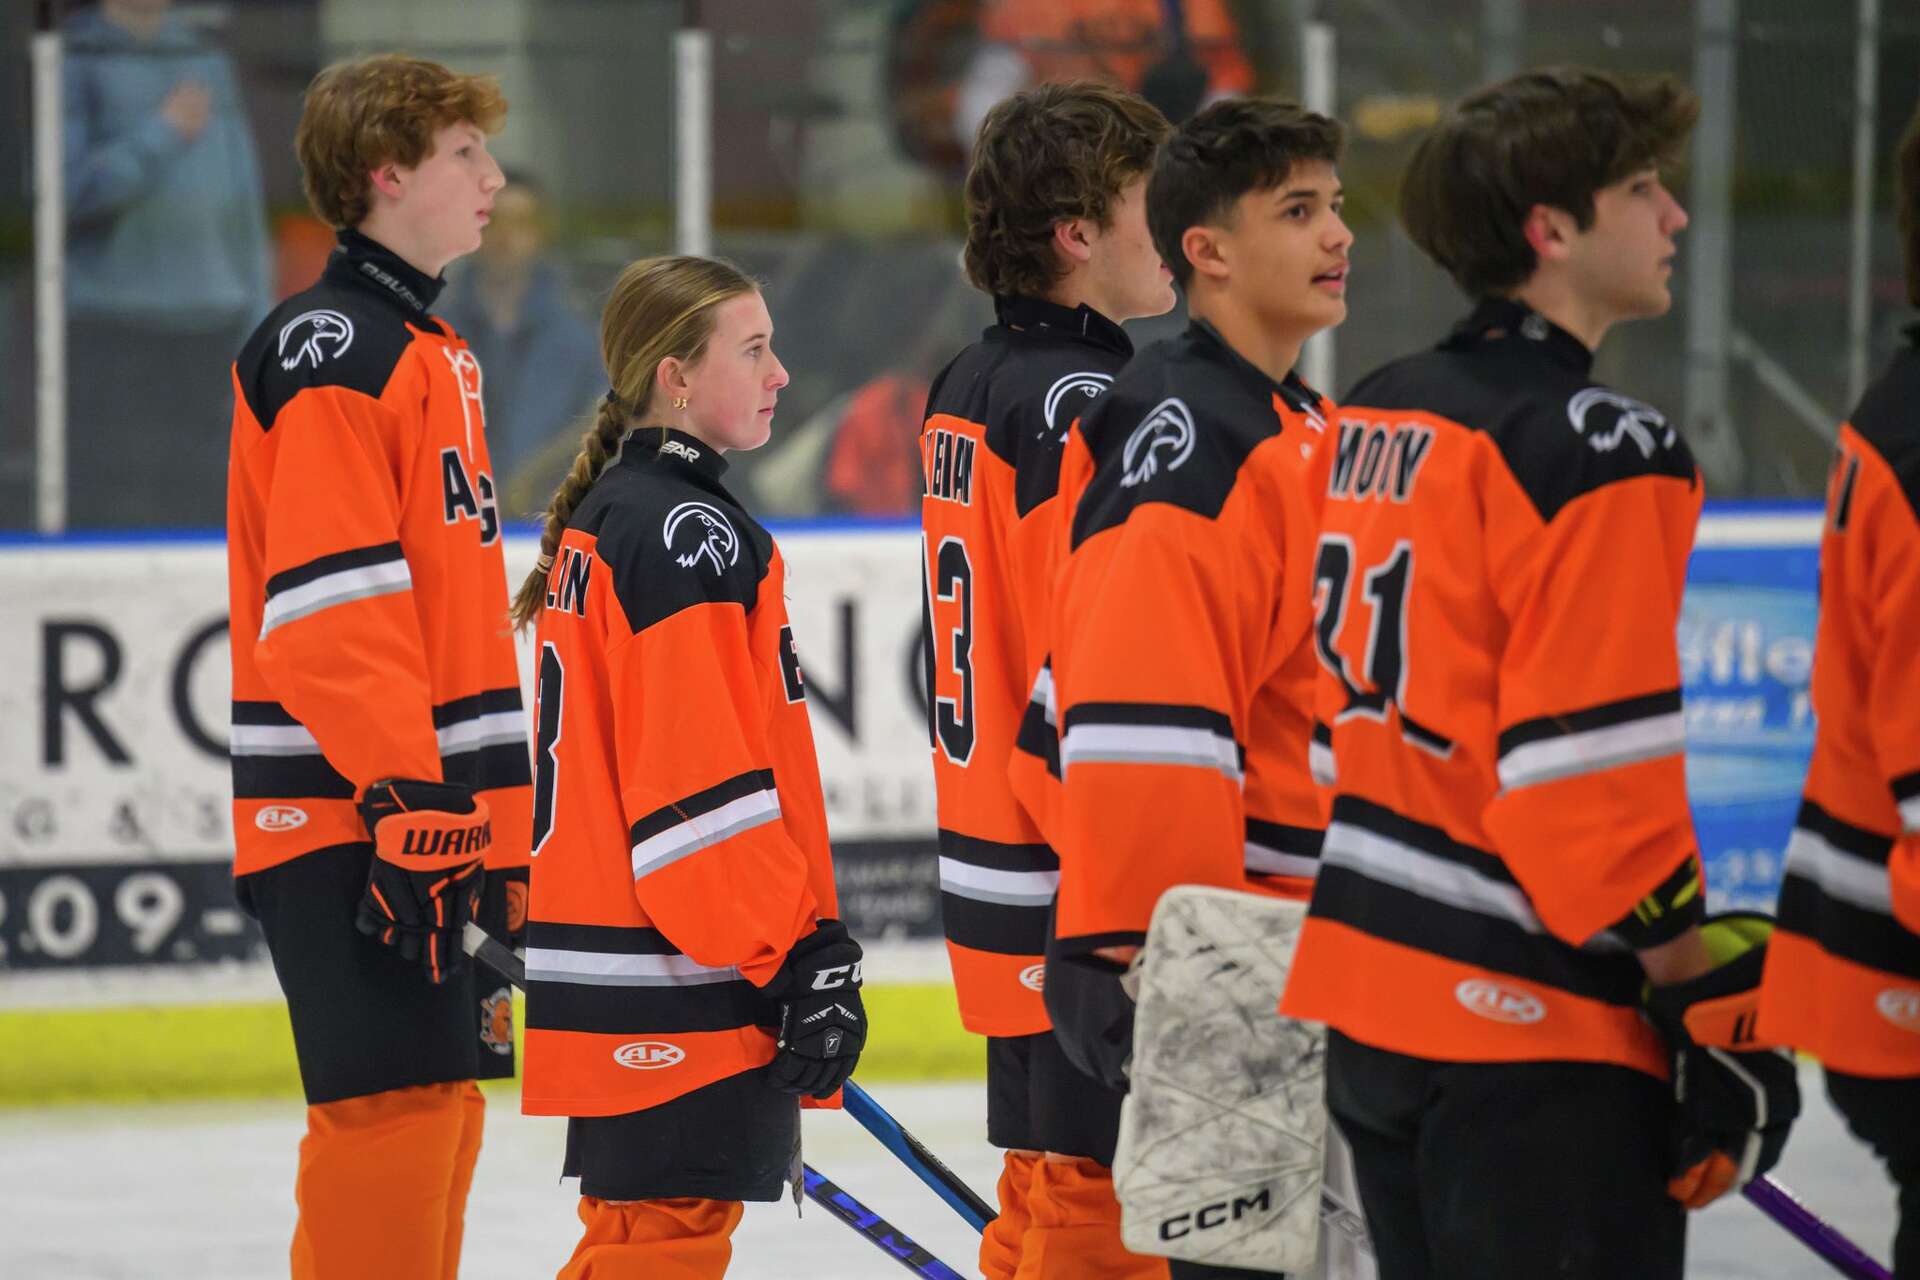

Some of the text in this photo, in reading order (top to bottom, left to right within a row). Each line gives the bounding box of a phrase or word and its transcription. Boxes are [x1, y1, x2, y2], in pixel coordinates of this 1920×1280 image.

[921, 531, 976, 768] 3
[0, 871, 246, 959] 09-
[613, 1041, 686, 1069] AK
[1159, 1187, 1271, 1242] CCM
